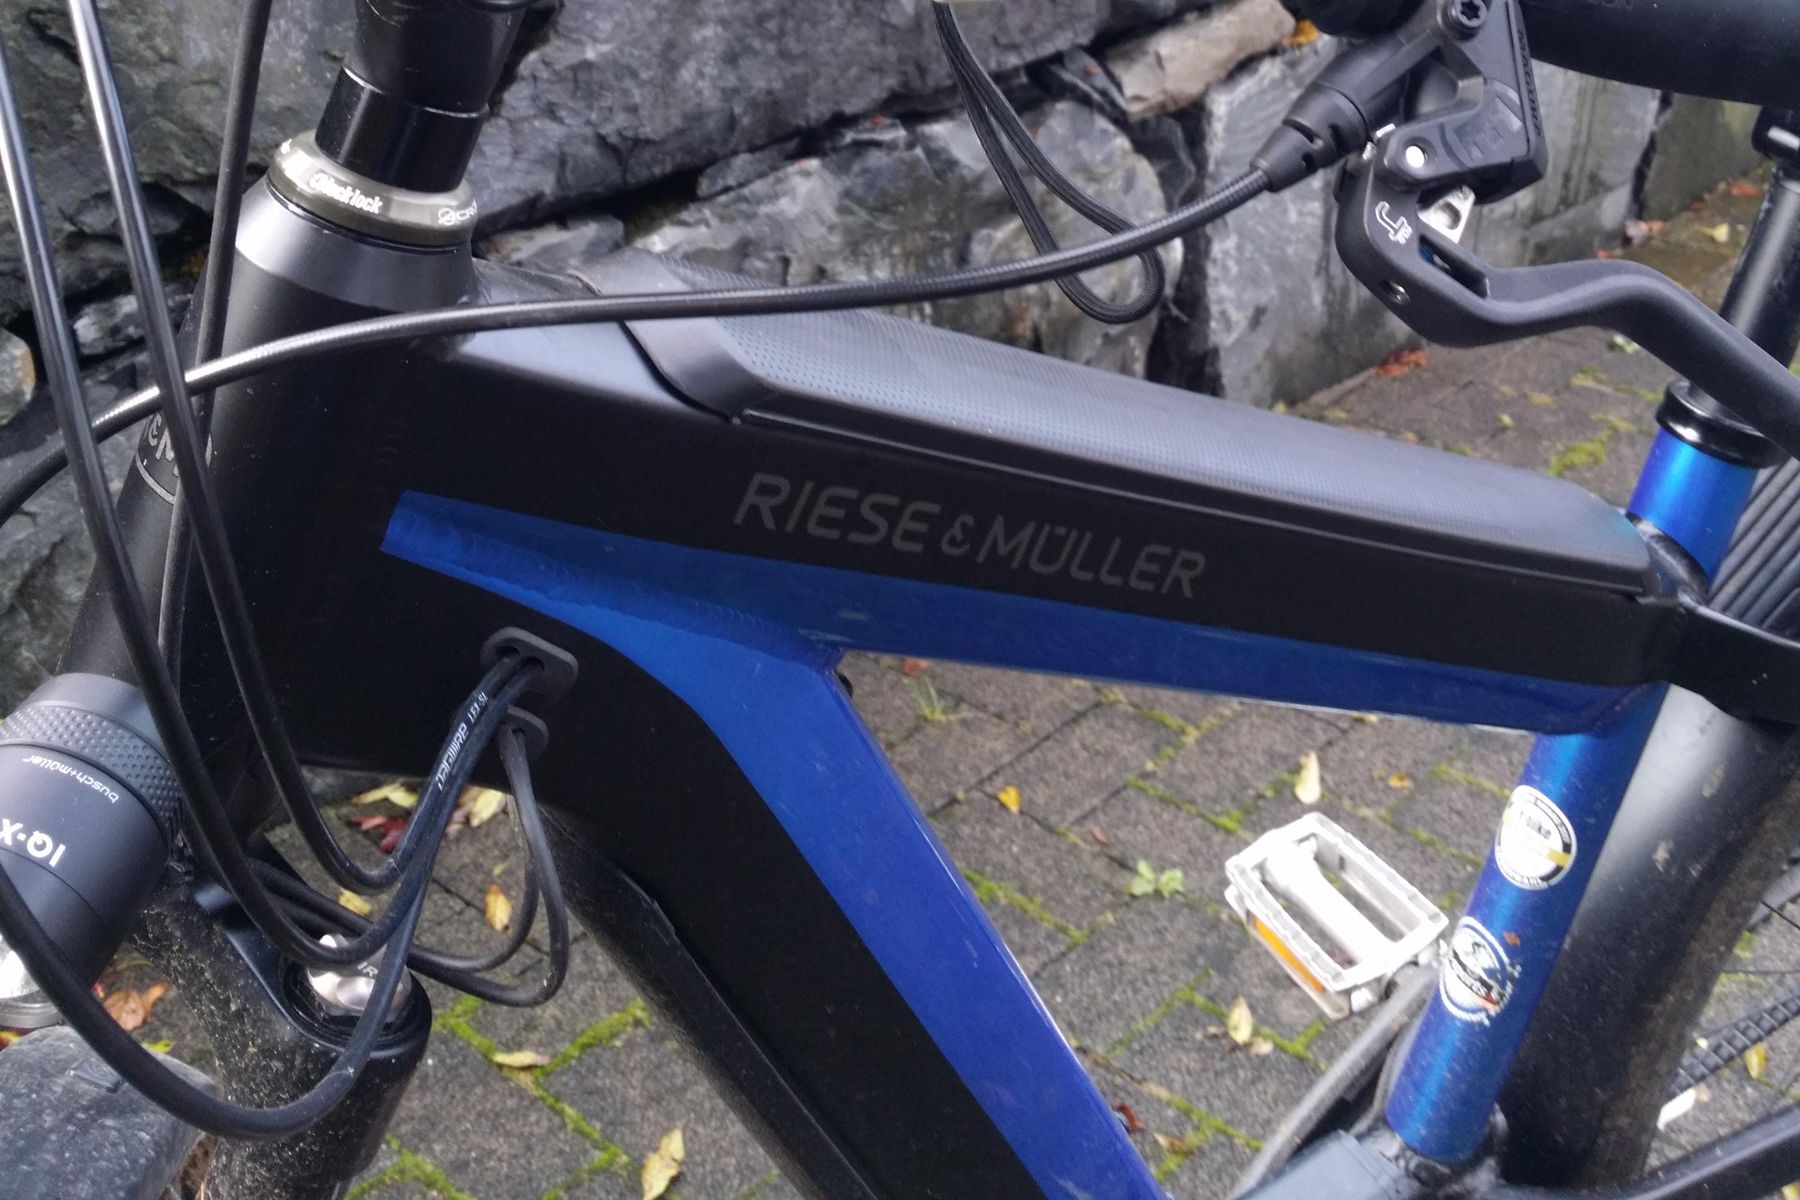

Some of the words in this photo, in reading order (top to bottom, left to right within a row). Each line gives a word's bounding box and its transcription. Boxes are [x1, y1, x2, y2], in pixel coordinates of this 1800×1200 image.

[733, 471, 941, 554] RIESE
[940, 513, 976, 557] &
[976, 514, 1207, 599] MÜLLER
